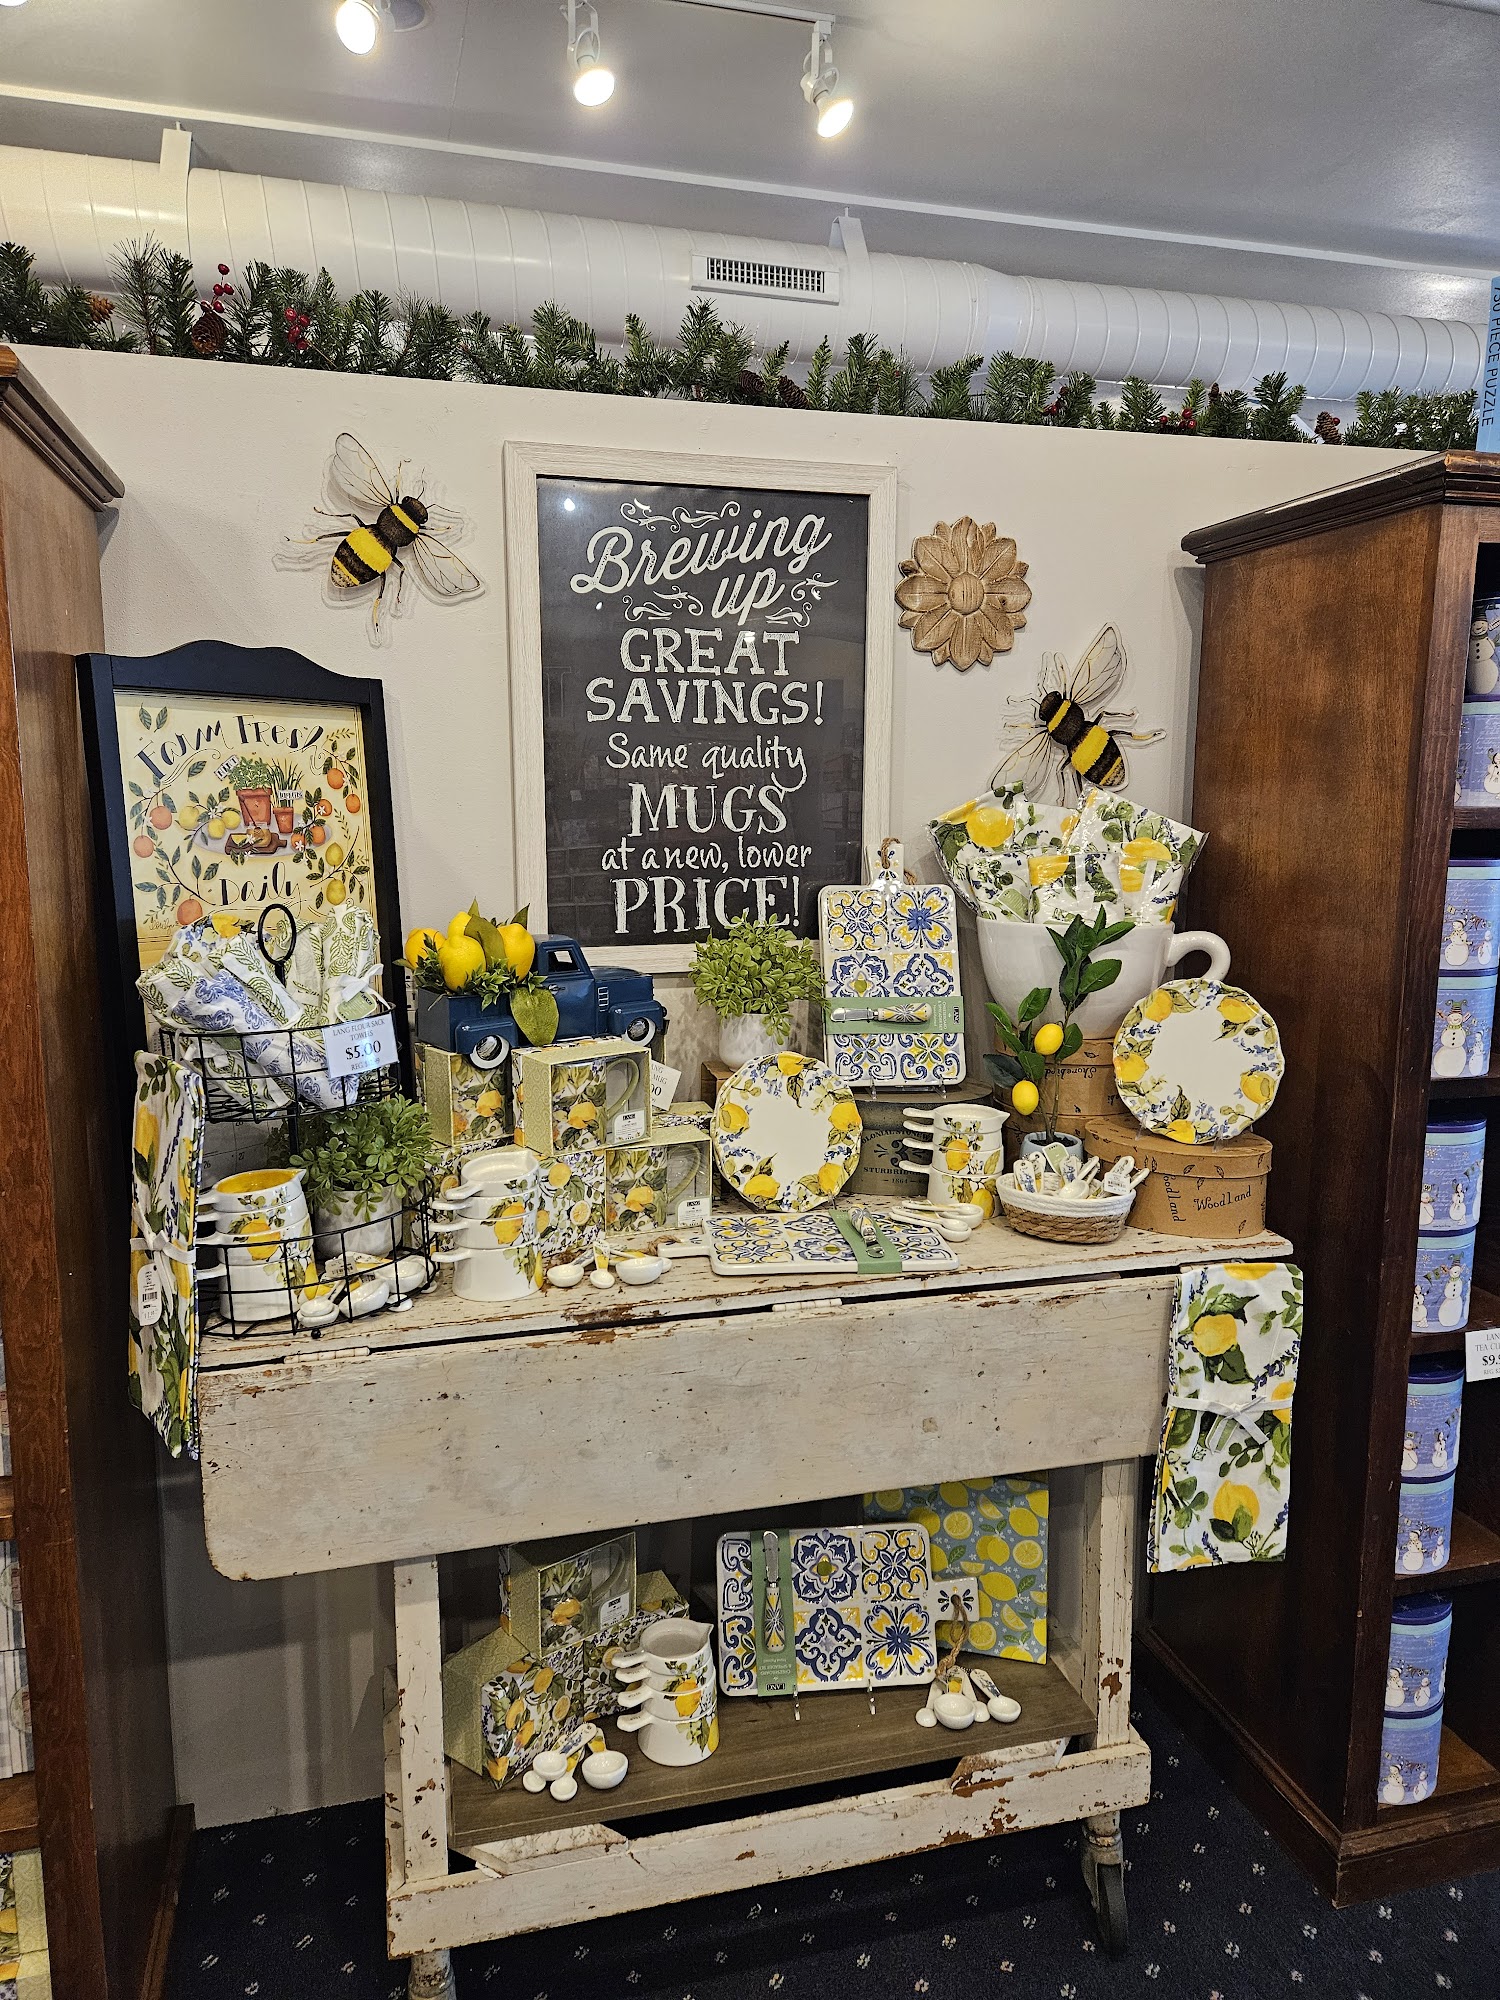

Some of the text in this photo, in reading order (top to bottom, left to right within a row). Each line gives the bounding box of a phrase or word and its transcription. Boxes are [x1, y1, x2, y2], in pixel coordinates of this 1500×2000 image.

[1488, 318, 1500, 364] PIECE
[1481, 368, 1498, 427] PUZZLE
[570, 509, 832, 594] Brewing
[711, 567, 786, 626] up
[620, 627, 800, 676] GREAT
[585, 676, 824, 726] SAVINGS!
[134, 714, 325, 779] Farm Fresh
[606, 732, 807, 792] Same quality
[627, 782, 787, 837] MUGS
[601, 834, 812, 873] at a new, lower
[219, 861, 302, 910] Daily
[610, 875, 800, 934] PRICE!
[333, 1026, 350, 1036] LANG
[351, 1022, 370, 1032] FLOUR
[345, 1039, 381, 1060] $5.00
[351, 1030, 373, 1040] TOWELS
[861, 1129, 892, 1144] OLONIAL
[1163, 1174, 1186, 1222] oodland
[1193, 1185, 1252, 1211] Woodland
[1475, 1344, 1488, 1352] TEA
